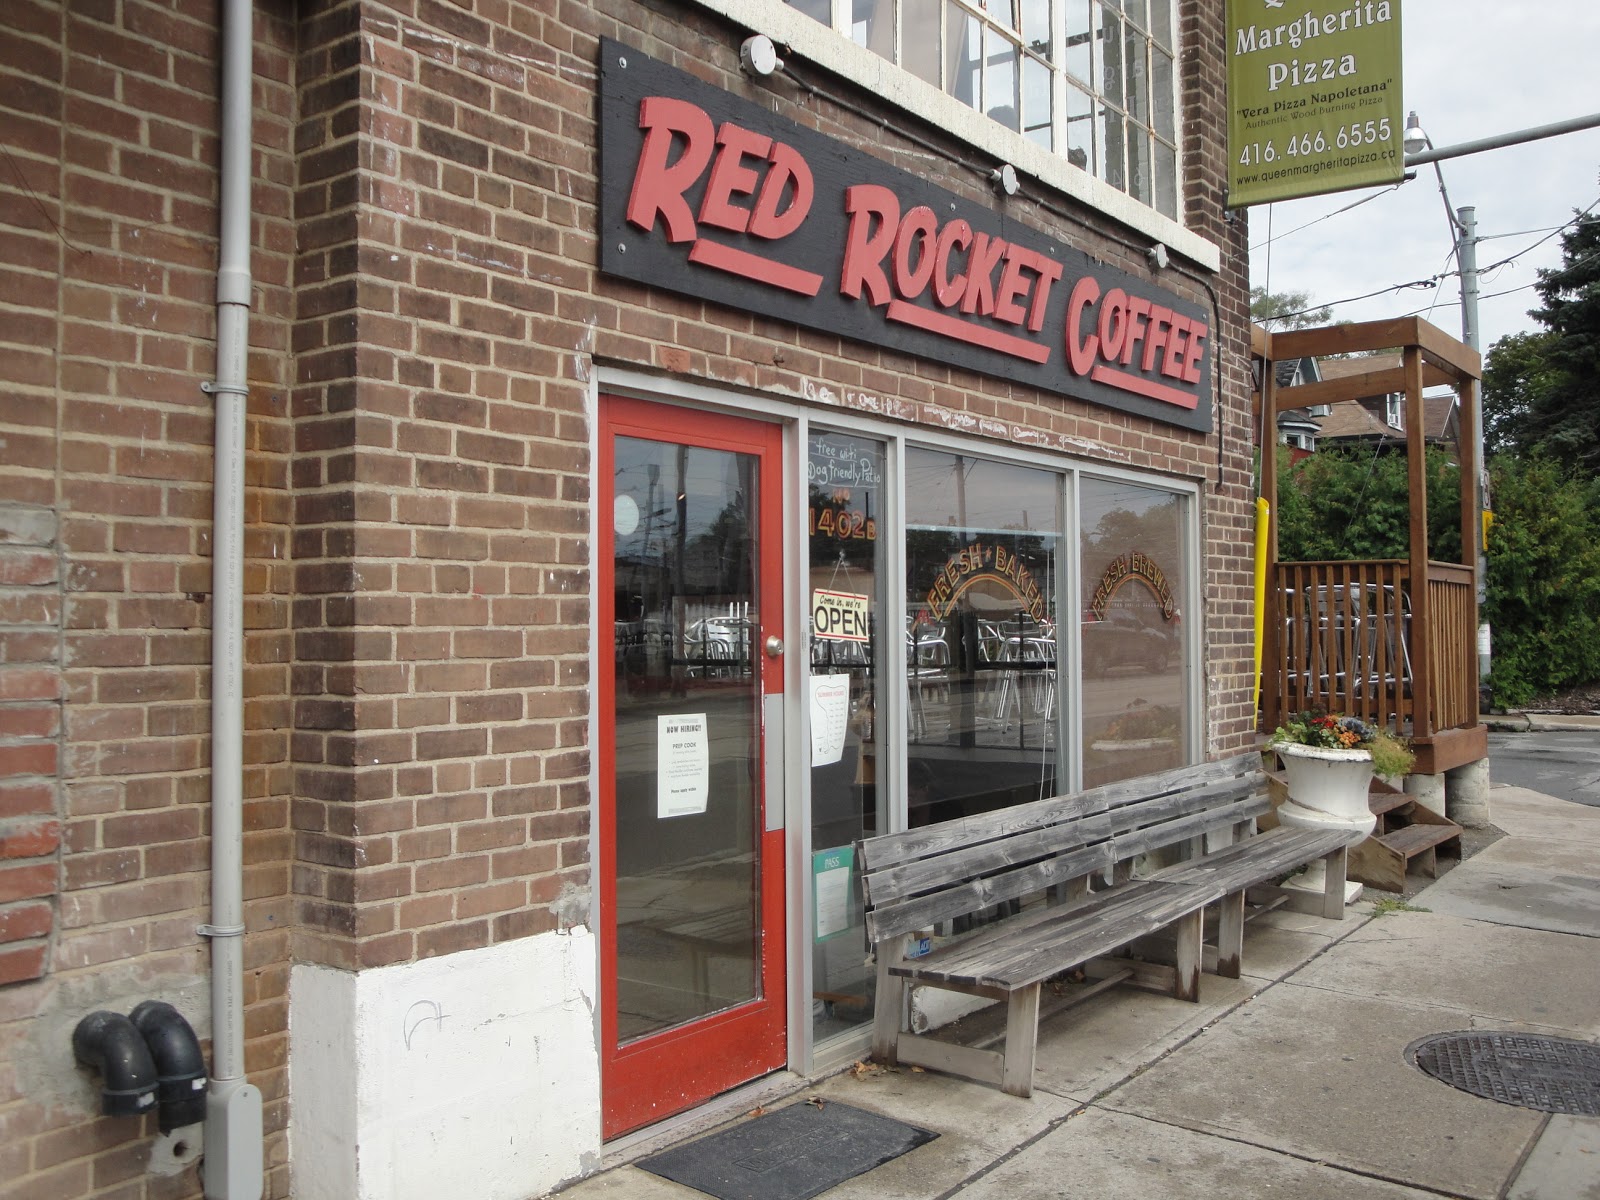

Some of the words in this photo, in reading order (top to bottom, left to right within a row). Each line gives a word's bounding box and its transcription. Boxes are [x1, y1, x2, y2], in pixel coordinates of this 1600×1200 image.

[1235, 1, 1391, 56] Margherita
[1268, 53, 1357, 92] Pizza
[1246, 116, 1287, 130] Authentic
[1291, 108, 1317, 120] Wood
[1319, 102, 1356, 115] Burning
[1359, 96, 1383, 107] Pizza
[1274, 100, 1306, 113] Pizza
[1311, 79, 1392, 105] Napoletana"
[1236, 150, 1396, 185] www.queenmargheritapizza.ca
[626, 97, 814, 243] RED
[840, 184, 1064, 333] ROCKET
[1066, 276, 1207, 385] COFFEE
[808, 461, 828, 485] Dog
[828, 459, 860, 488] friendly
[860, 458, 880, 483] Patio
[927, 543, 983, 621] FRESH
[994, 545, 1044, 623] BAKED
[1092, 553, 1127, 621] FRESH
[1131, 550, 1174, 620] BREWED
[815, 605, 866, 637] OPEN
